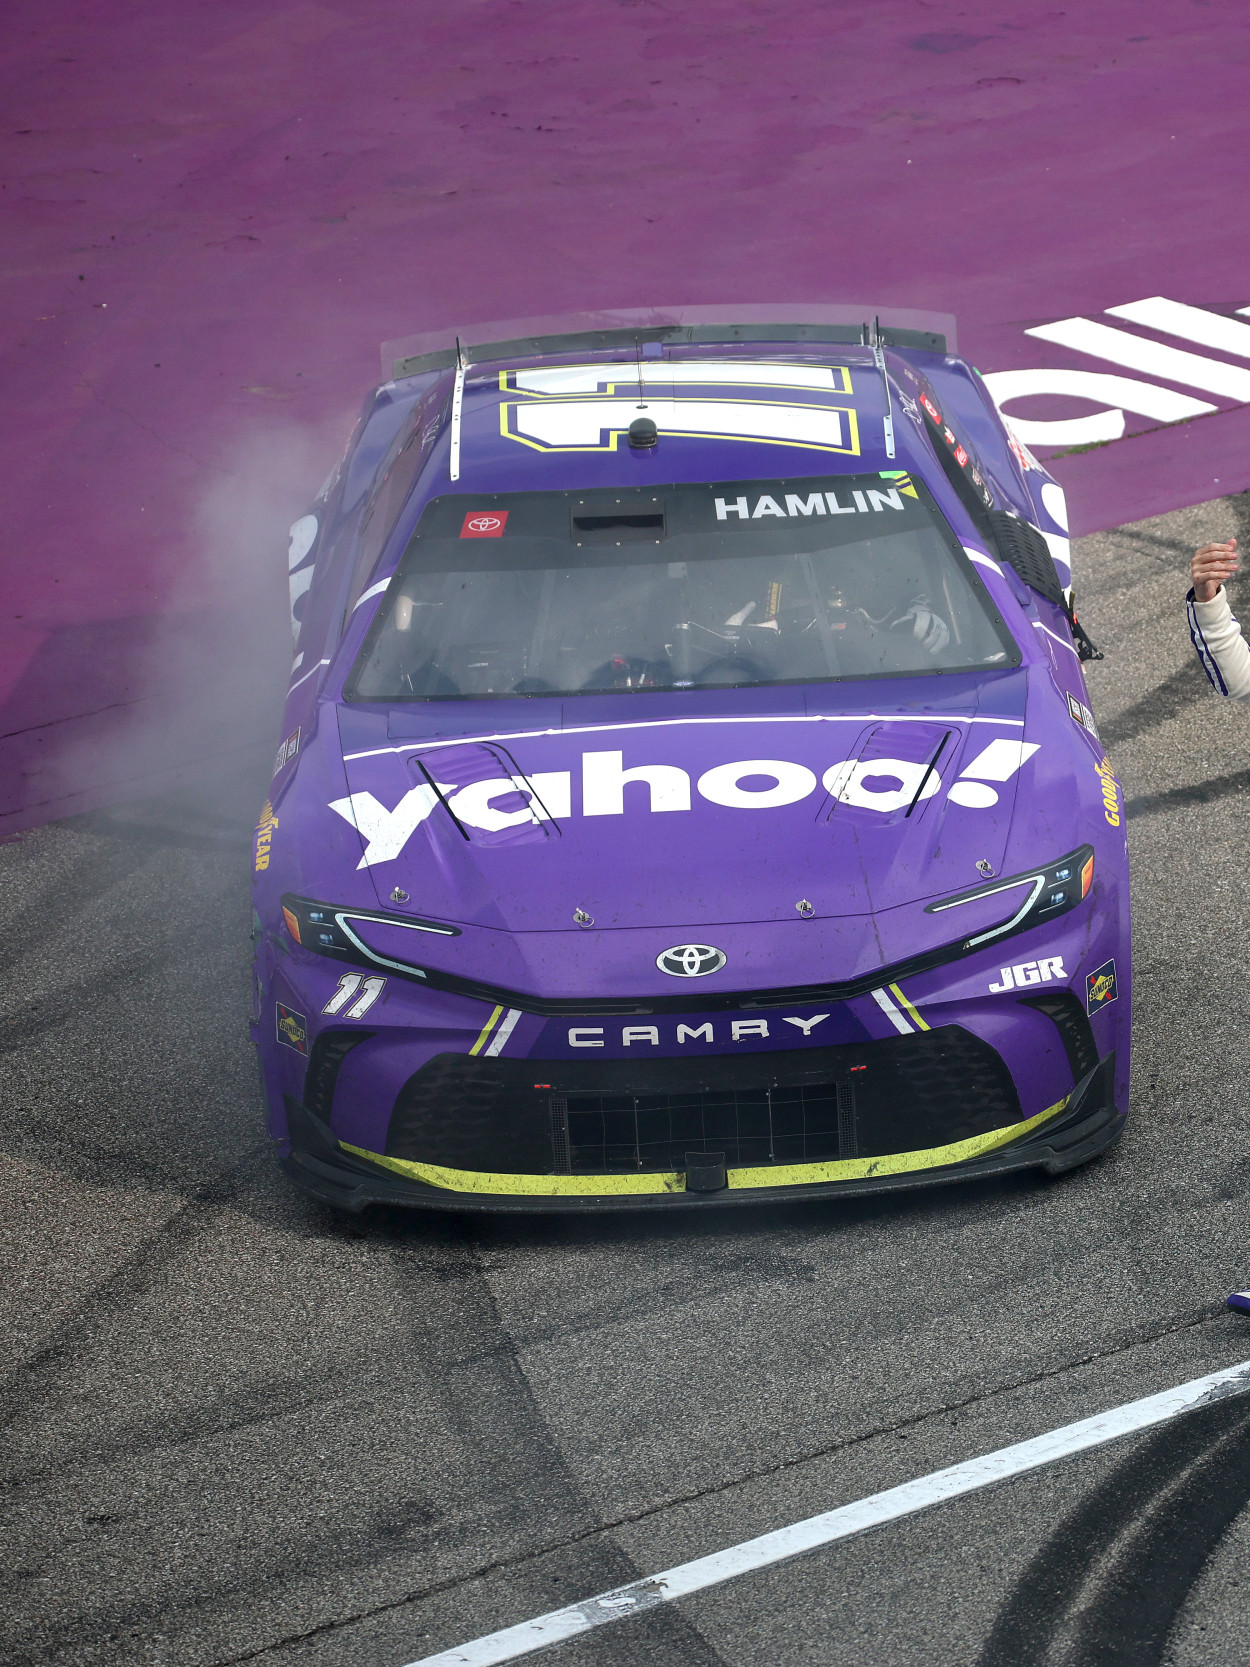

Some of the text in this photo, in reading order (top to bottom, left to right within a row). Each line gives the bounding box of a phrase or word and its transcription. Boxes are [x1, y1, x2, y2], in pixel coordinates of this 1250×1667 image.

[715, 488, 904, 520] HAMLIN
[326, 738, 1041, 869] yahoo!
[1094, 756, 1120, 827] GOODY
[988, 956, 1068, 993] JGR
[321, 972, 388, 1020] 11
[280, 1018, 306, 1041] SUNOCO
[568, 1013, 831, 1048] CAMRY
